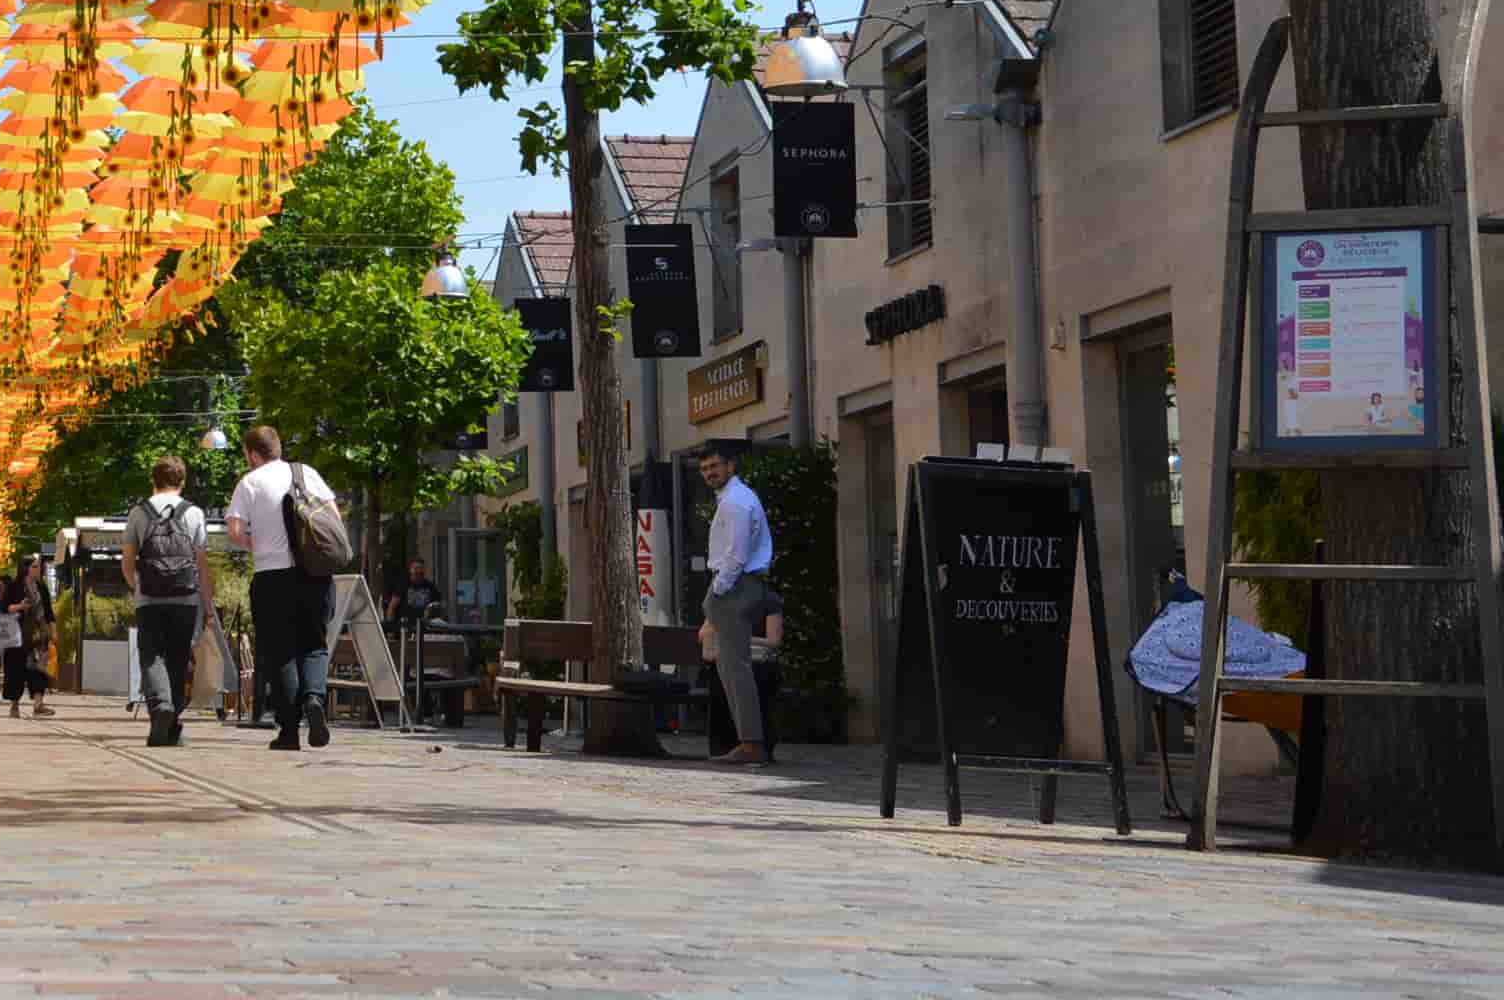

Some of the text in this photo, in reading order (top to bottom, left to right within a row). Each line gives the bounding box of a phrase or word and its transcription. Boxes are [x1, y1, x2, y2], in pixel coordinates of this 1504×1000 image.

[783, 147, 848, 159] SEPHORA
[959, 534, 1062, 568] NATURE
[999, 569, 1016, 593] &
